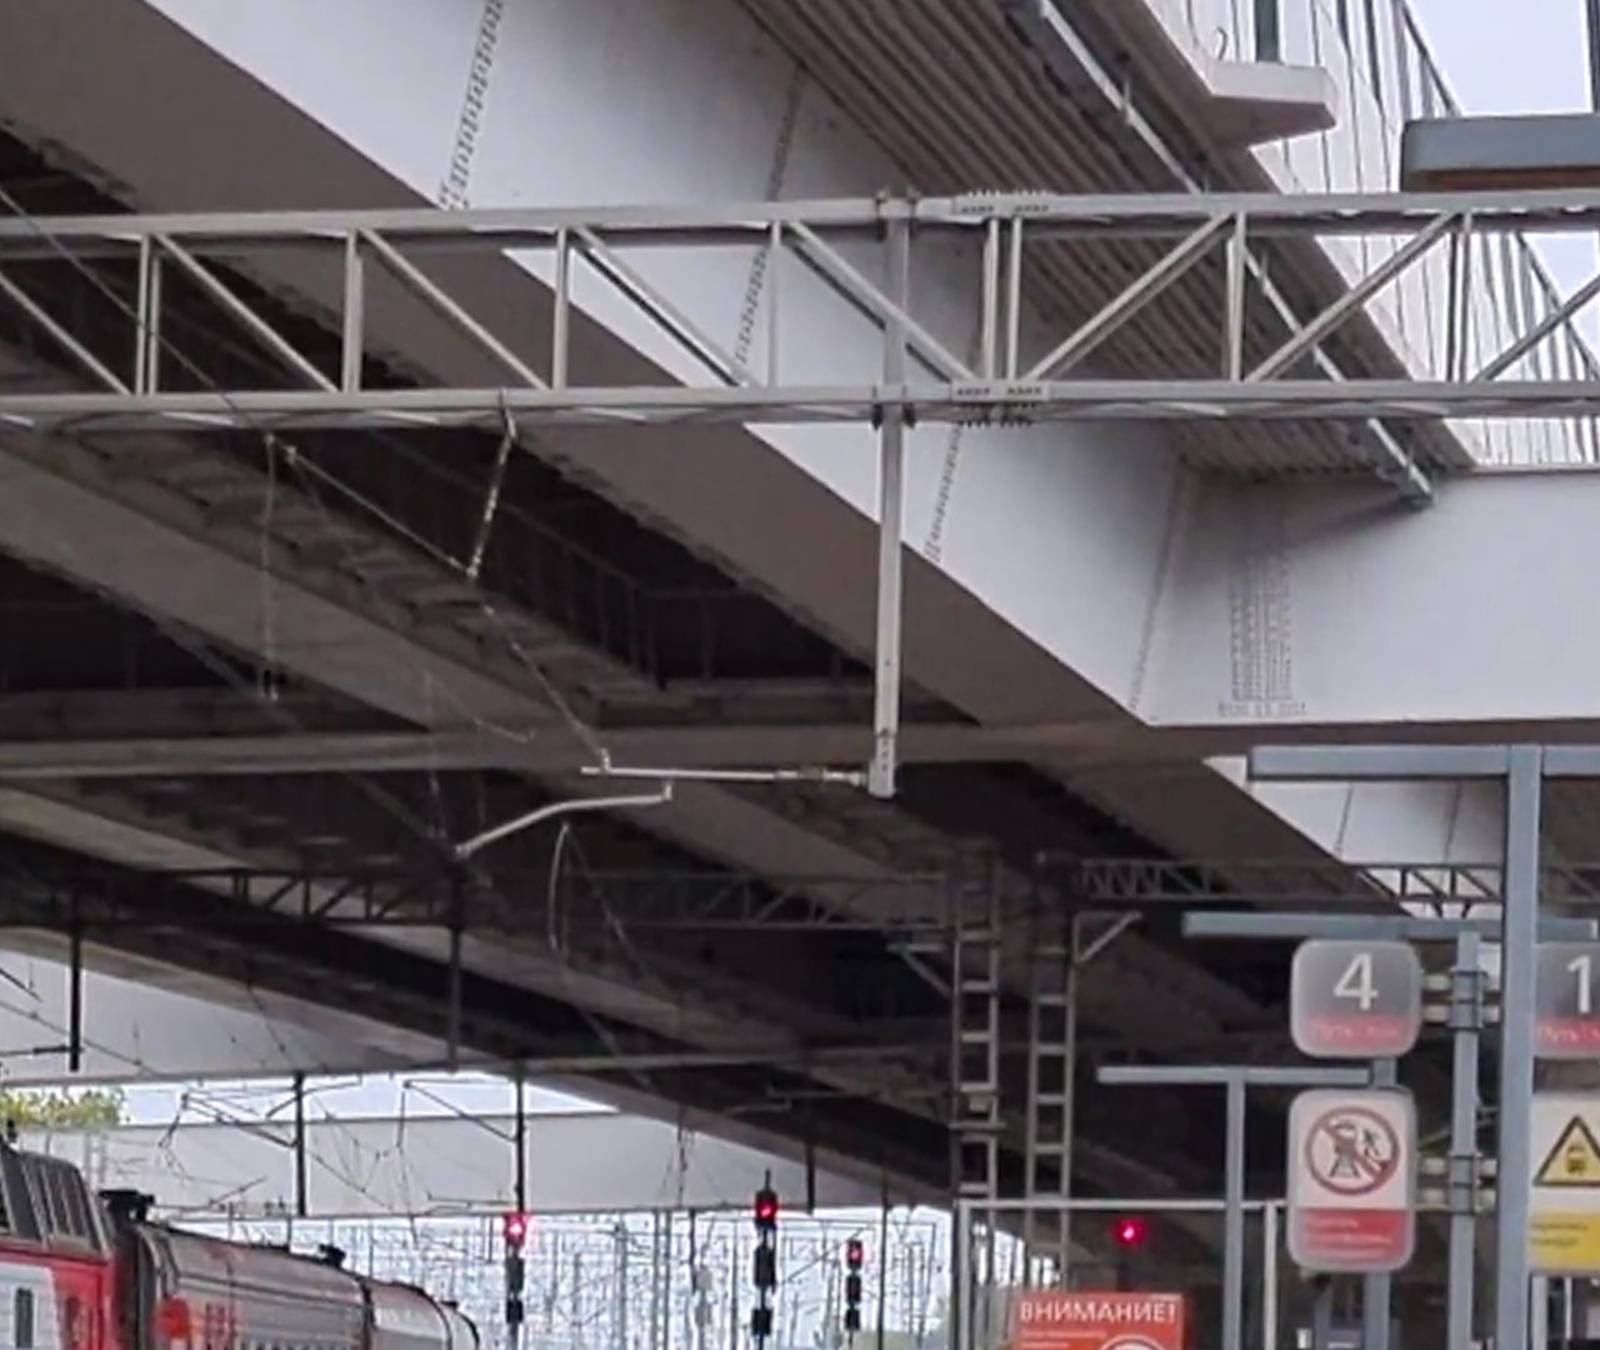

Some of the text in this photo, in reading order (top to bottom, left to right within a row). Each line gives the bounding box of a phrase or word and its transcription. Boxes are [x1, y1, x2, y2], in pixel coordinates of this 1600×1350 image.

[1333, 953, 1378, 1010] 4
[1567, 955, 1591, 1013] 1
[1020, 1301, 1176, 1323] ВНИМАНИЕ!
